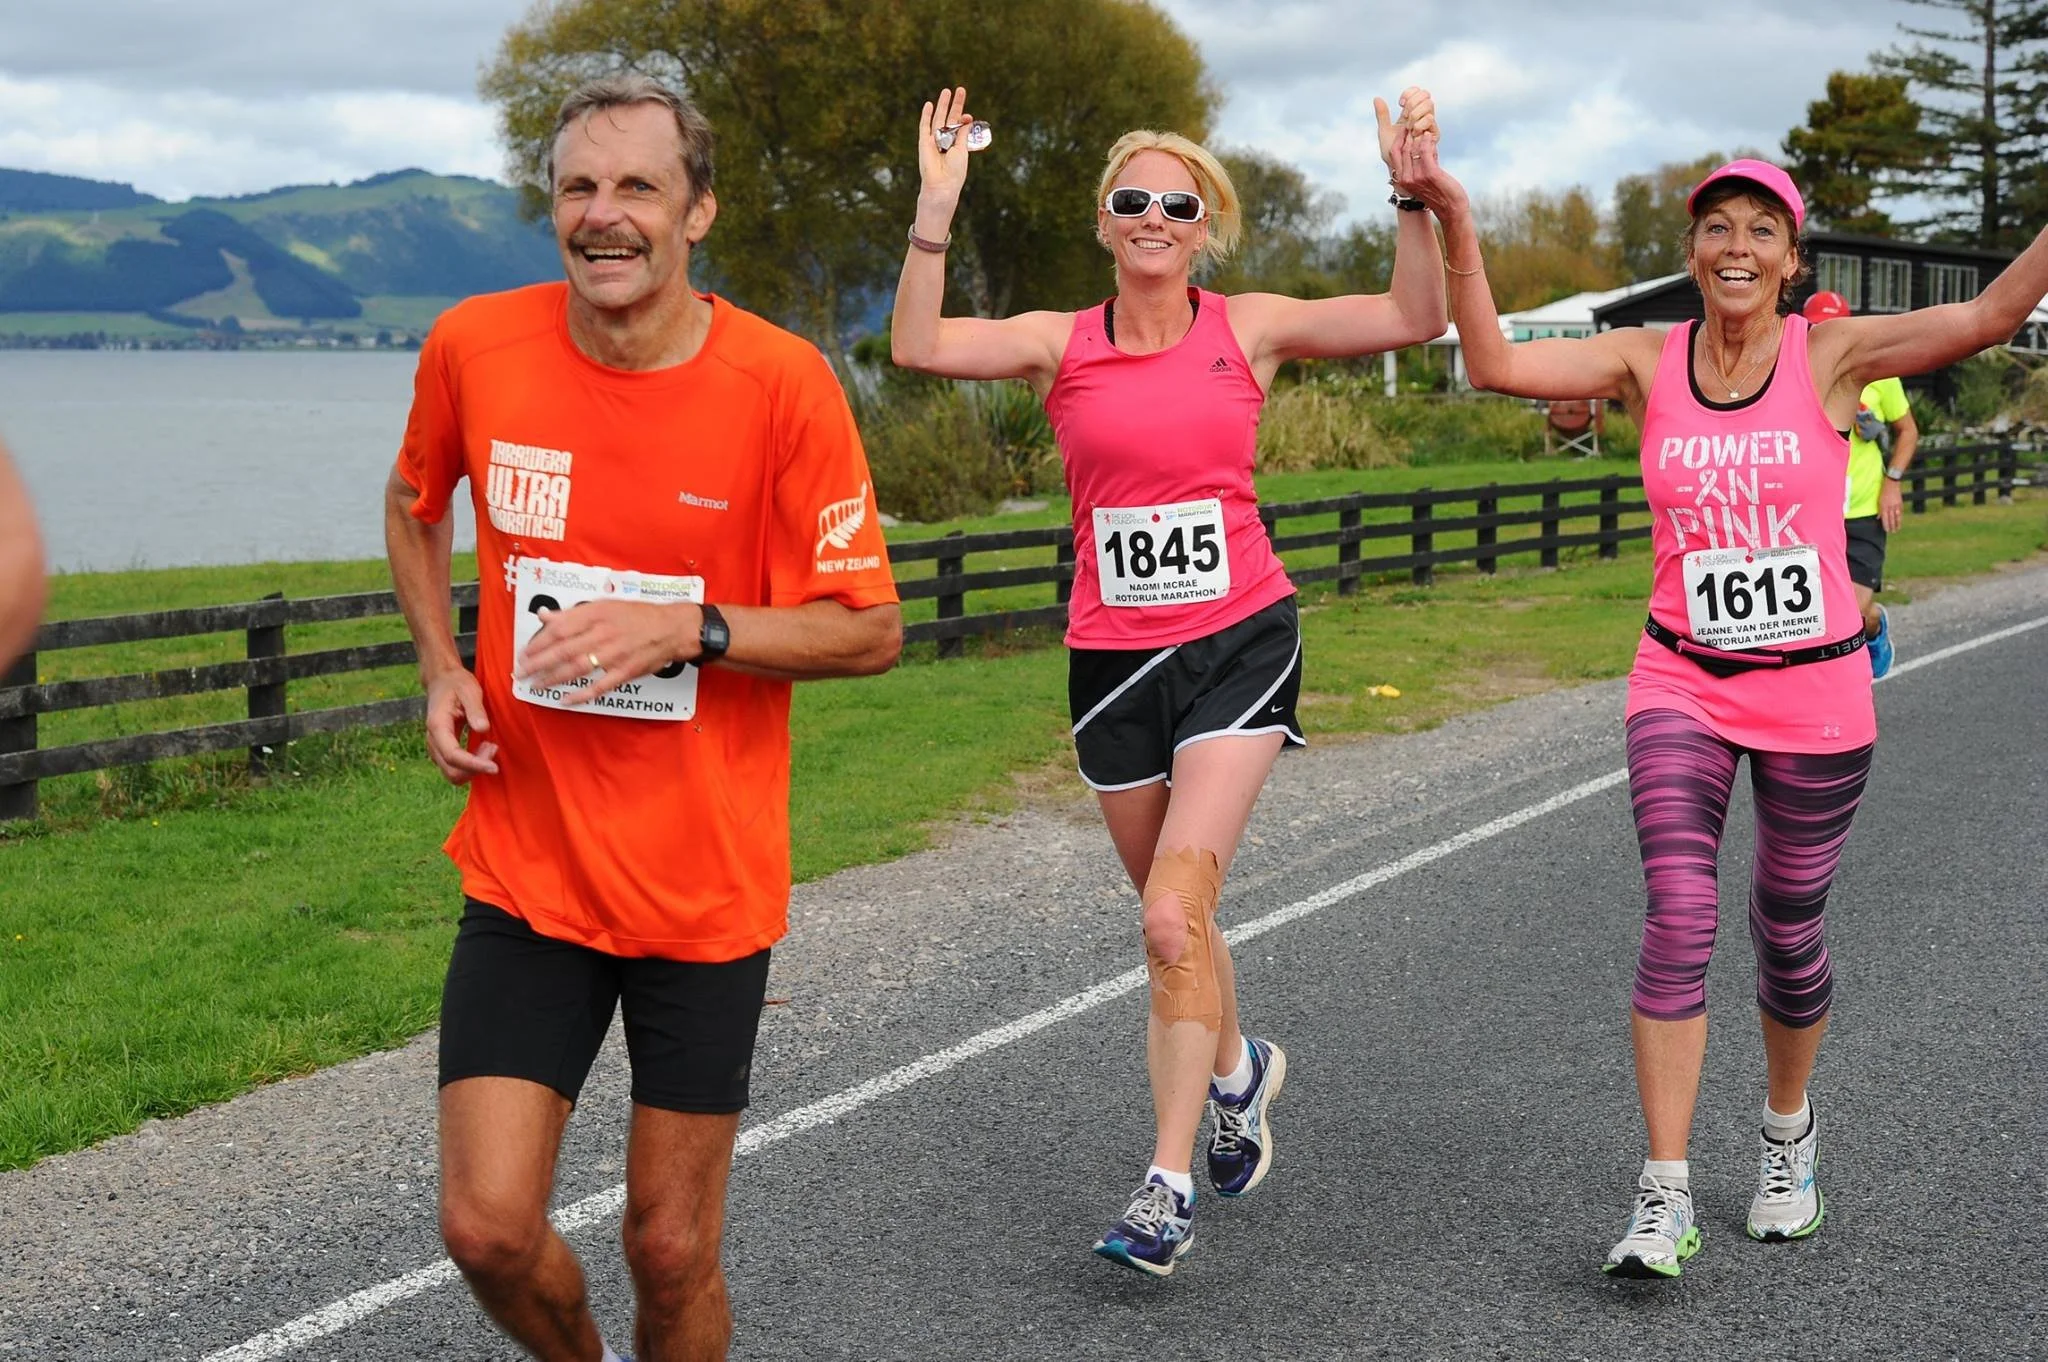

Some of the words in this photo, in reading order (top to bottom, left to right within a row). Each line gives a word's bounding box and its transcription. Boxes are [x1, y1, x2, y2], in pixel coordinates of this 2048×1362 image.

[1659, 431, 1801, 470] POWER
[486, 463, 571, 519] ULTRA
[679, 491, 728, 511] Marmot
[487, 505, 566, 542] MARATHON
[1666, 504, 1802, 549] PINK
[1104, 523, 1220, 579] 1845
[817, 559, 846, 574] NEW
[1115, 593, 1159, 602] ROTORUA
[1161, 588, 1217, 601] MARATHON
[1129, 583, 1160, 592] NAOMI
[1163, 579, 1198, 589] MCRAE
[1697, 564, 1812, 622] 1613
[1696, 626, 1733, 636] JEANNE
[1736, 624, 1757, 633] VAN
[1760, 620, 1780, 631] DER
[1782, 615, 1819, 627] MERWE
[1705, 635, 1752, 646] ROTORUA
[1754, 627, 1811, 642] MARATHON
[1817, 634, 1867, 659] PIBELT
[594, 696, 674, 712] MARATHON
